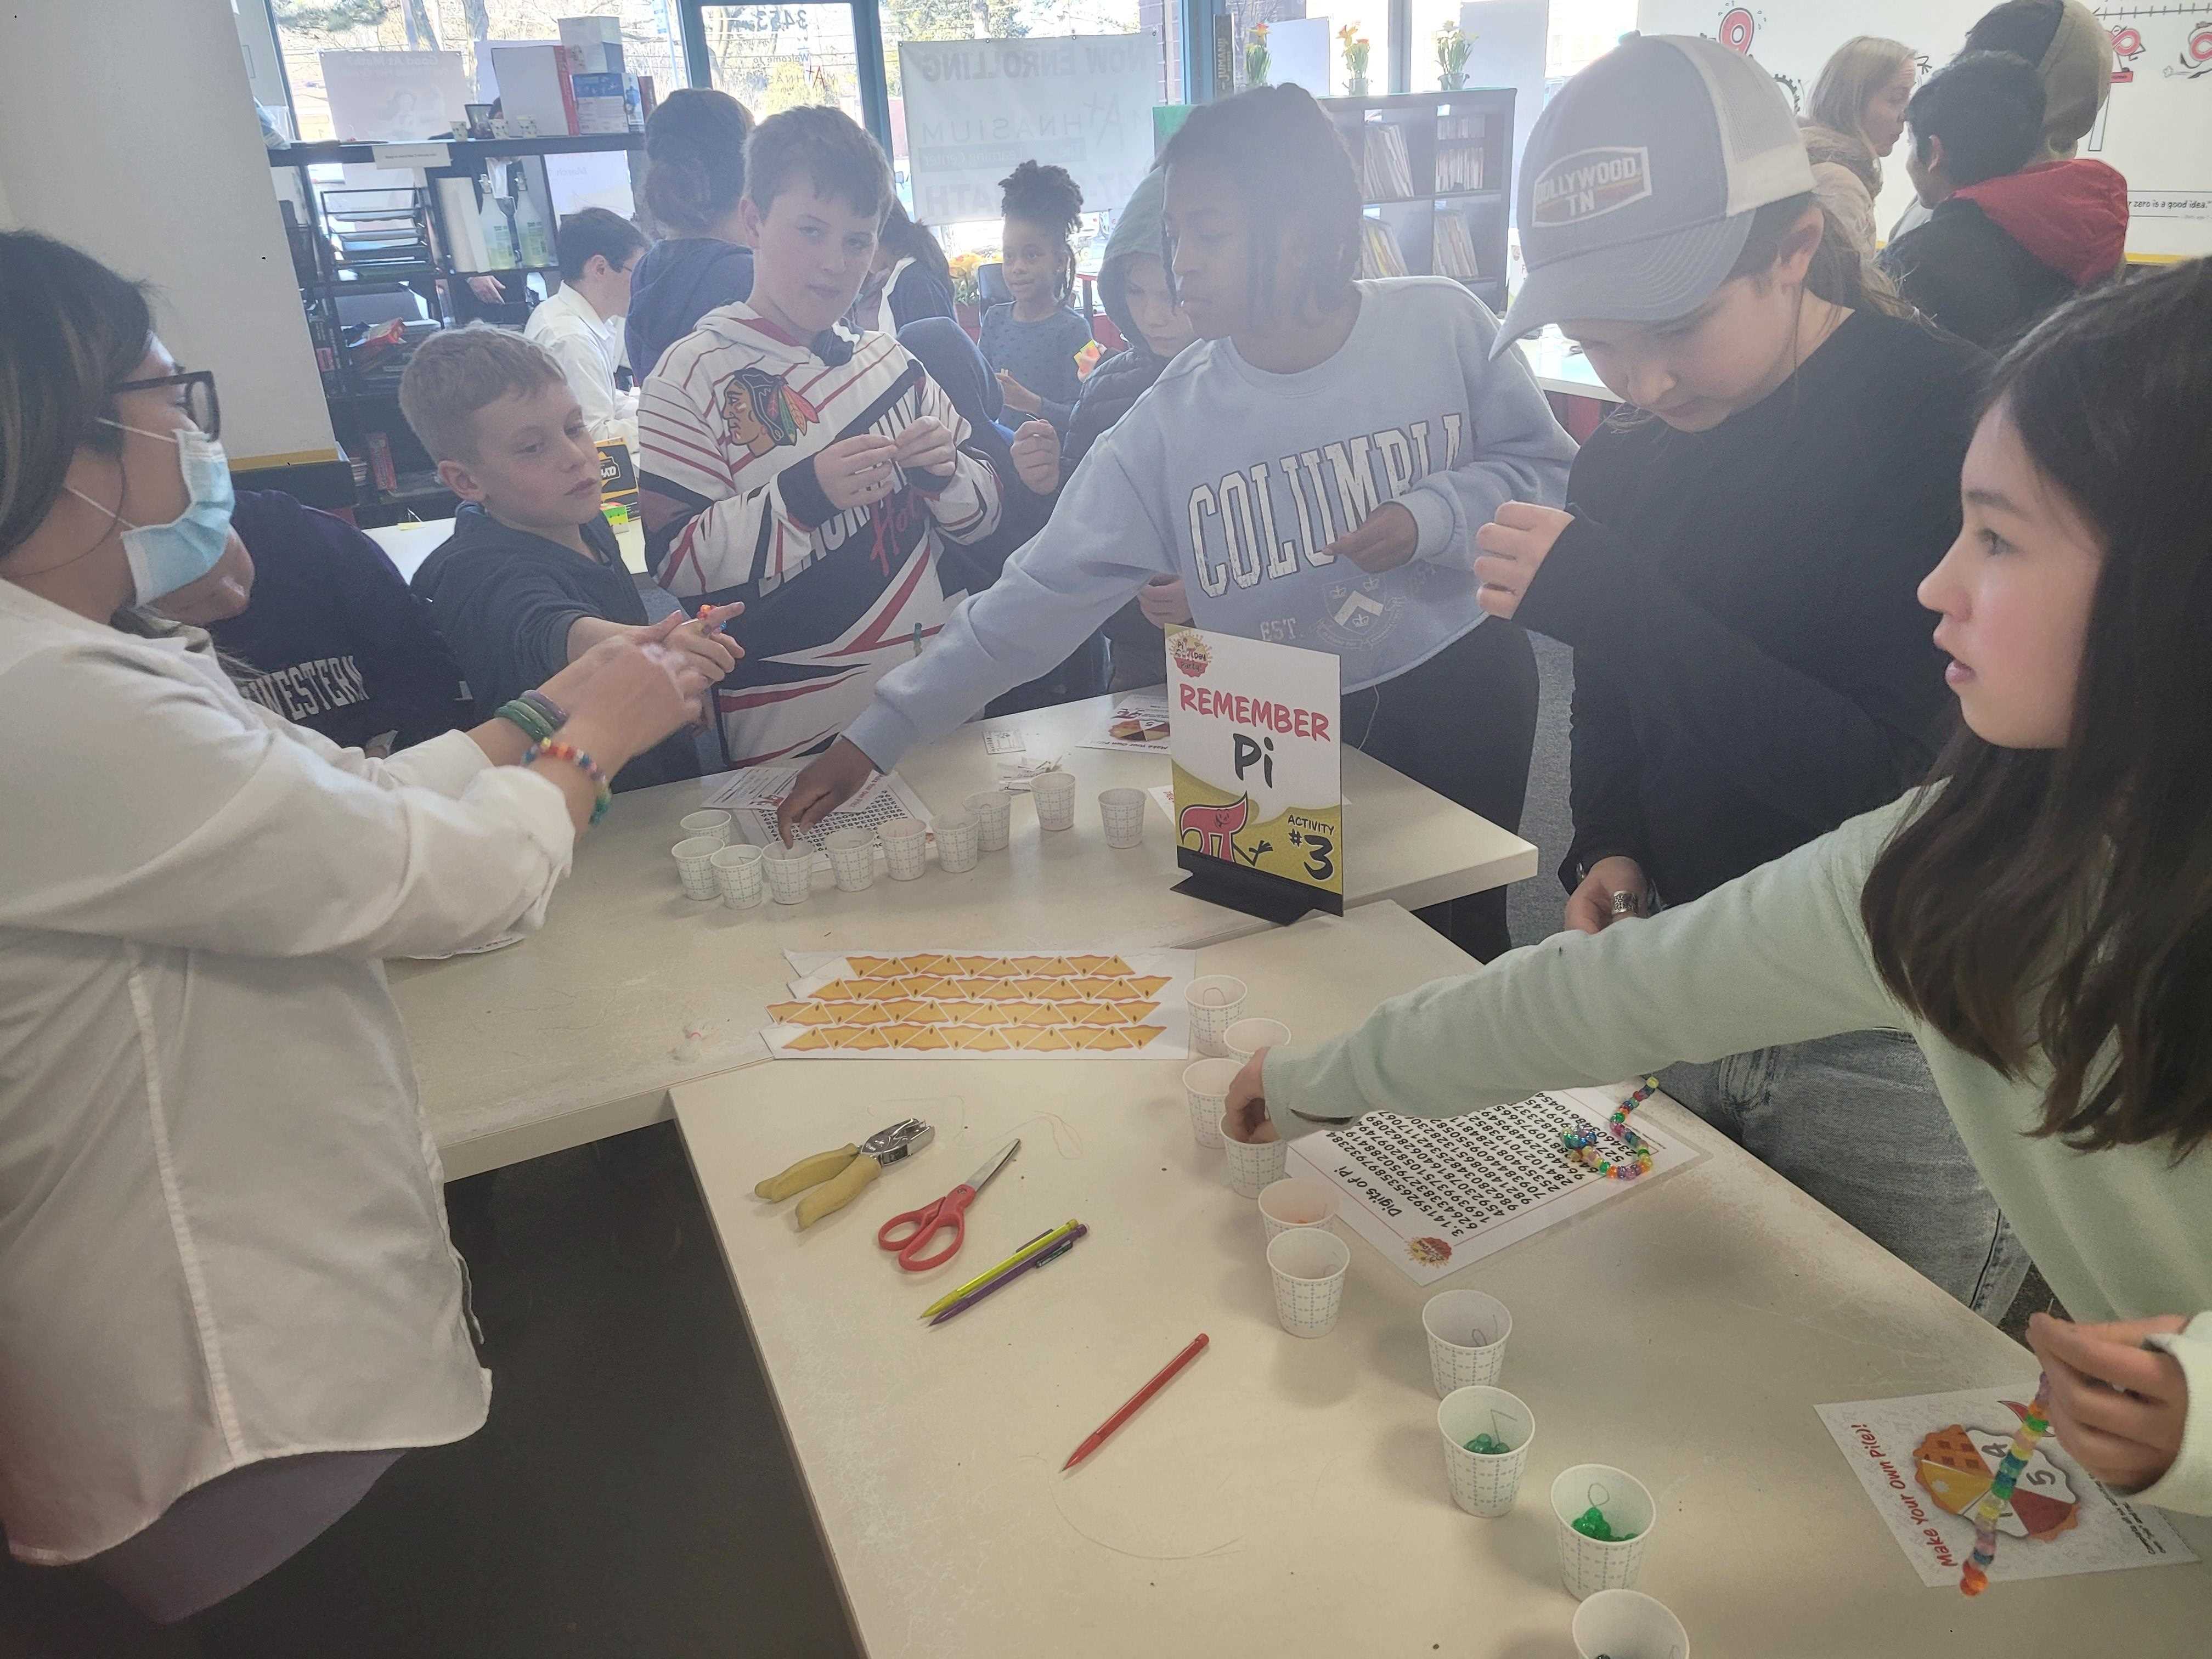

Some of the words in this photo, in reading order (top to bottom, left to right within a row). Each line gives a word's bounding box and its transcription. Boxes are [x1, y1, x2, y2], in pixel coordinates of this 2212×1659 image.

[1565, 190, 1595, 217] TN
[2152, 200, 2159, 208] is
[2167, 200, 2187, 210] good
[1180, 683, 1331, 742] REMEMBER
[1232, 732, 1274, 789] Pi
[1288, 815, 1335, 836] ACTIVITY
[1476, 1107, 1587, 1181] 96446229489549
[1334, 1166, 1353, 1177] Pi
[1340, 1128, 1480, 1231] 6264338327950288419
[1347, 1177, 1368, 1187] of
[1363, 1115, 1508, 1218] 45923078164062862089
[1323, 1131, 1466, 1237] 3.1415926535897932384
[1365, 1188, 1403, 1217] Digits
[1851, 1424, 1886, 1458] Pi(e)!
[1880, 1461, 1905, 1489] Own
[2026, 1470, 2056, 1485] 5
[1900, 1493, 1929, 1525] Your
[1923, 1528, 1957, 1567] Make
